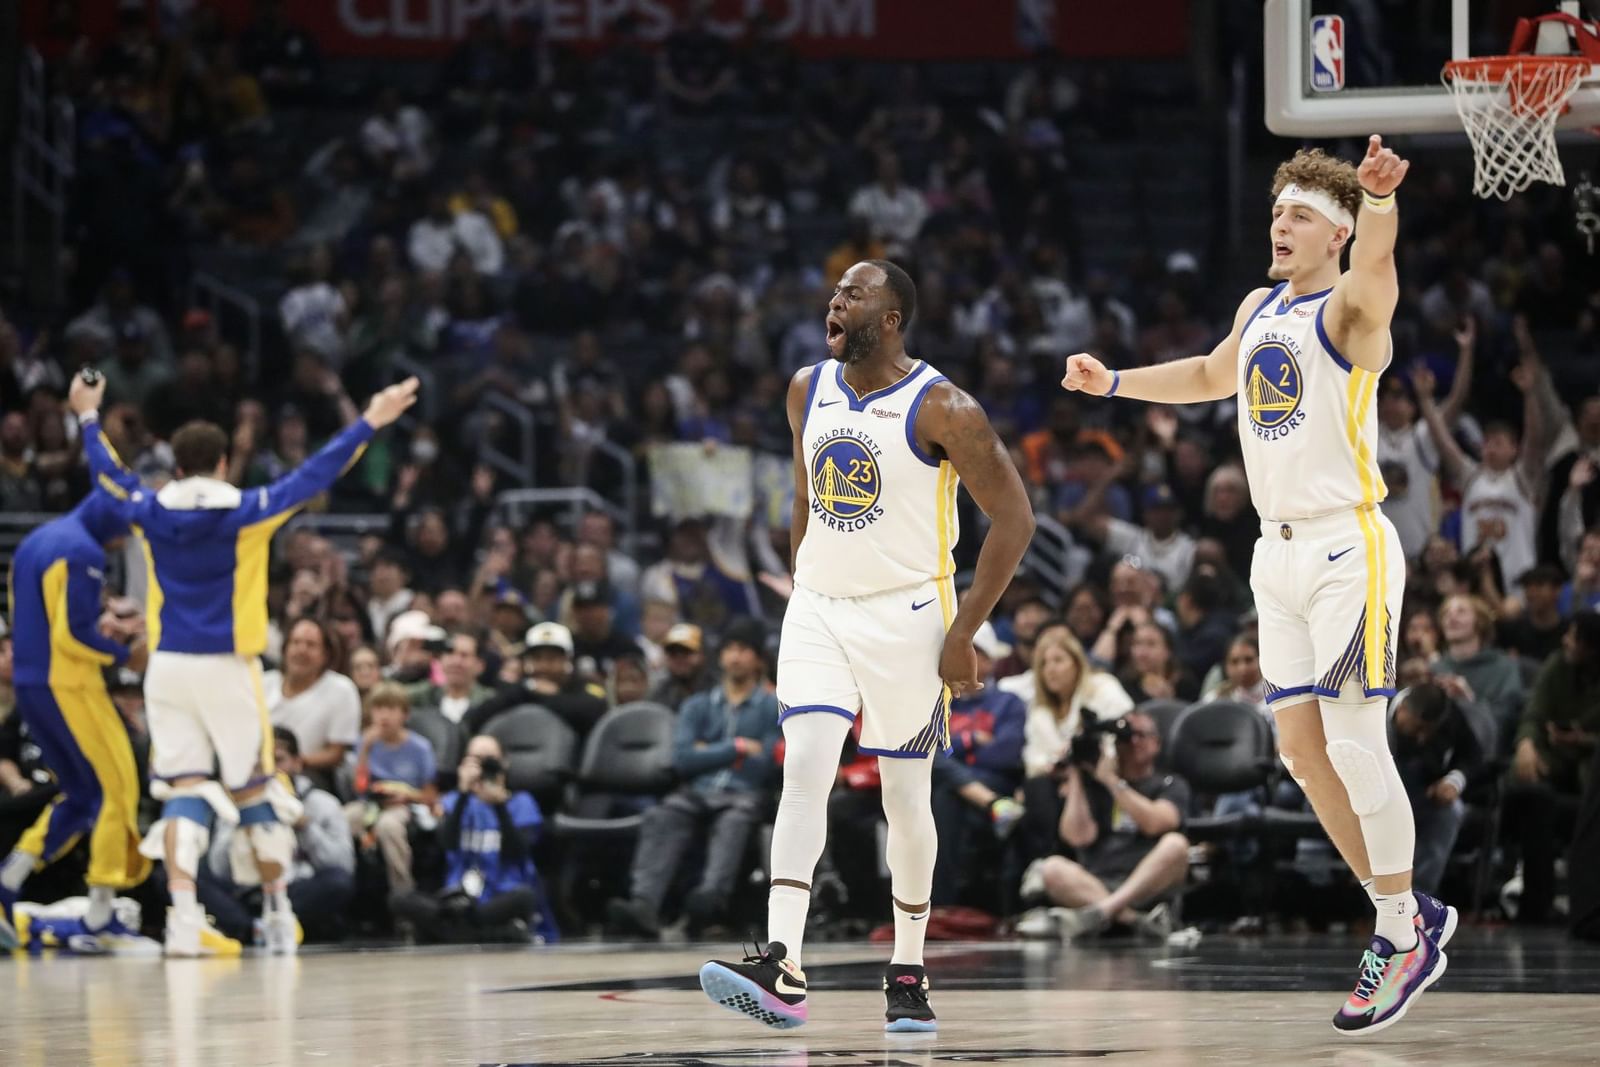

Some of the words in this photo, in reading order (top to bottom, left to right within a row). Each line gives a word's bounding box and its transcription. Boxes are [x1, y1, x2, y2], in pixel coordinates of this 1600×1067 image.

[338, 0, 877, 38] CLIPPESCOM
[1245, 332, 1278, 358] DEN
[1281, 334, 1302, 358] STATE
[1279, 363, 1291, 387] 2
[871, 408, 901, 420] Rakuten
[812, 428, 854, 451] GOLDEN
[857, 431, 883, 458] STATE
[848, 459, 872, 484] 23
[811, 497, 884, 533] WARRIORS
